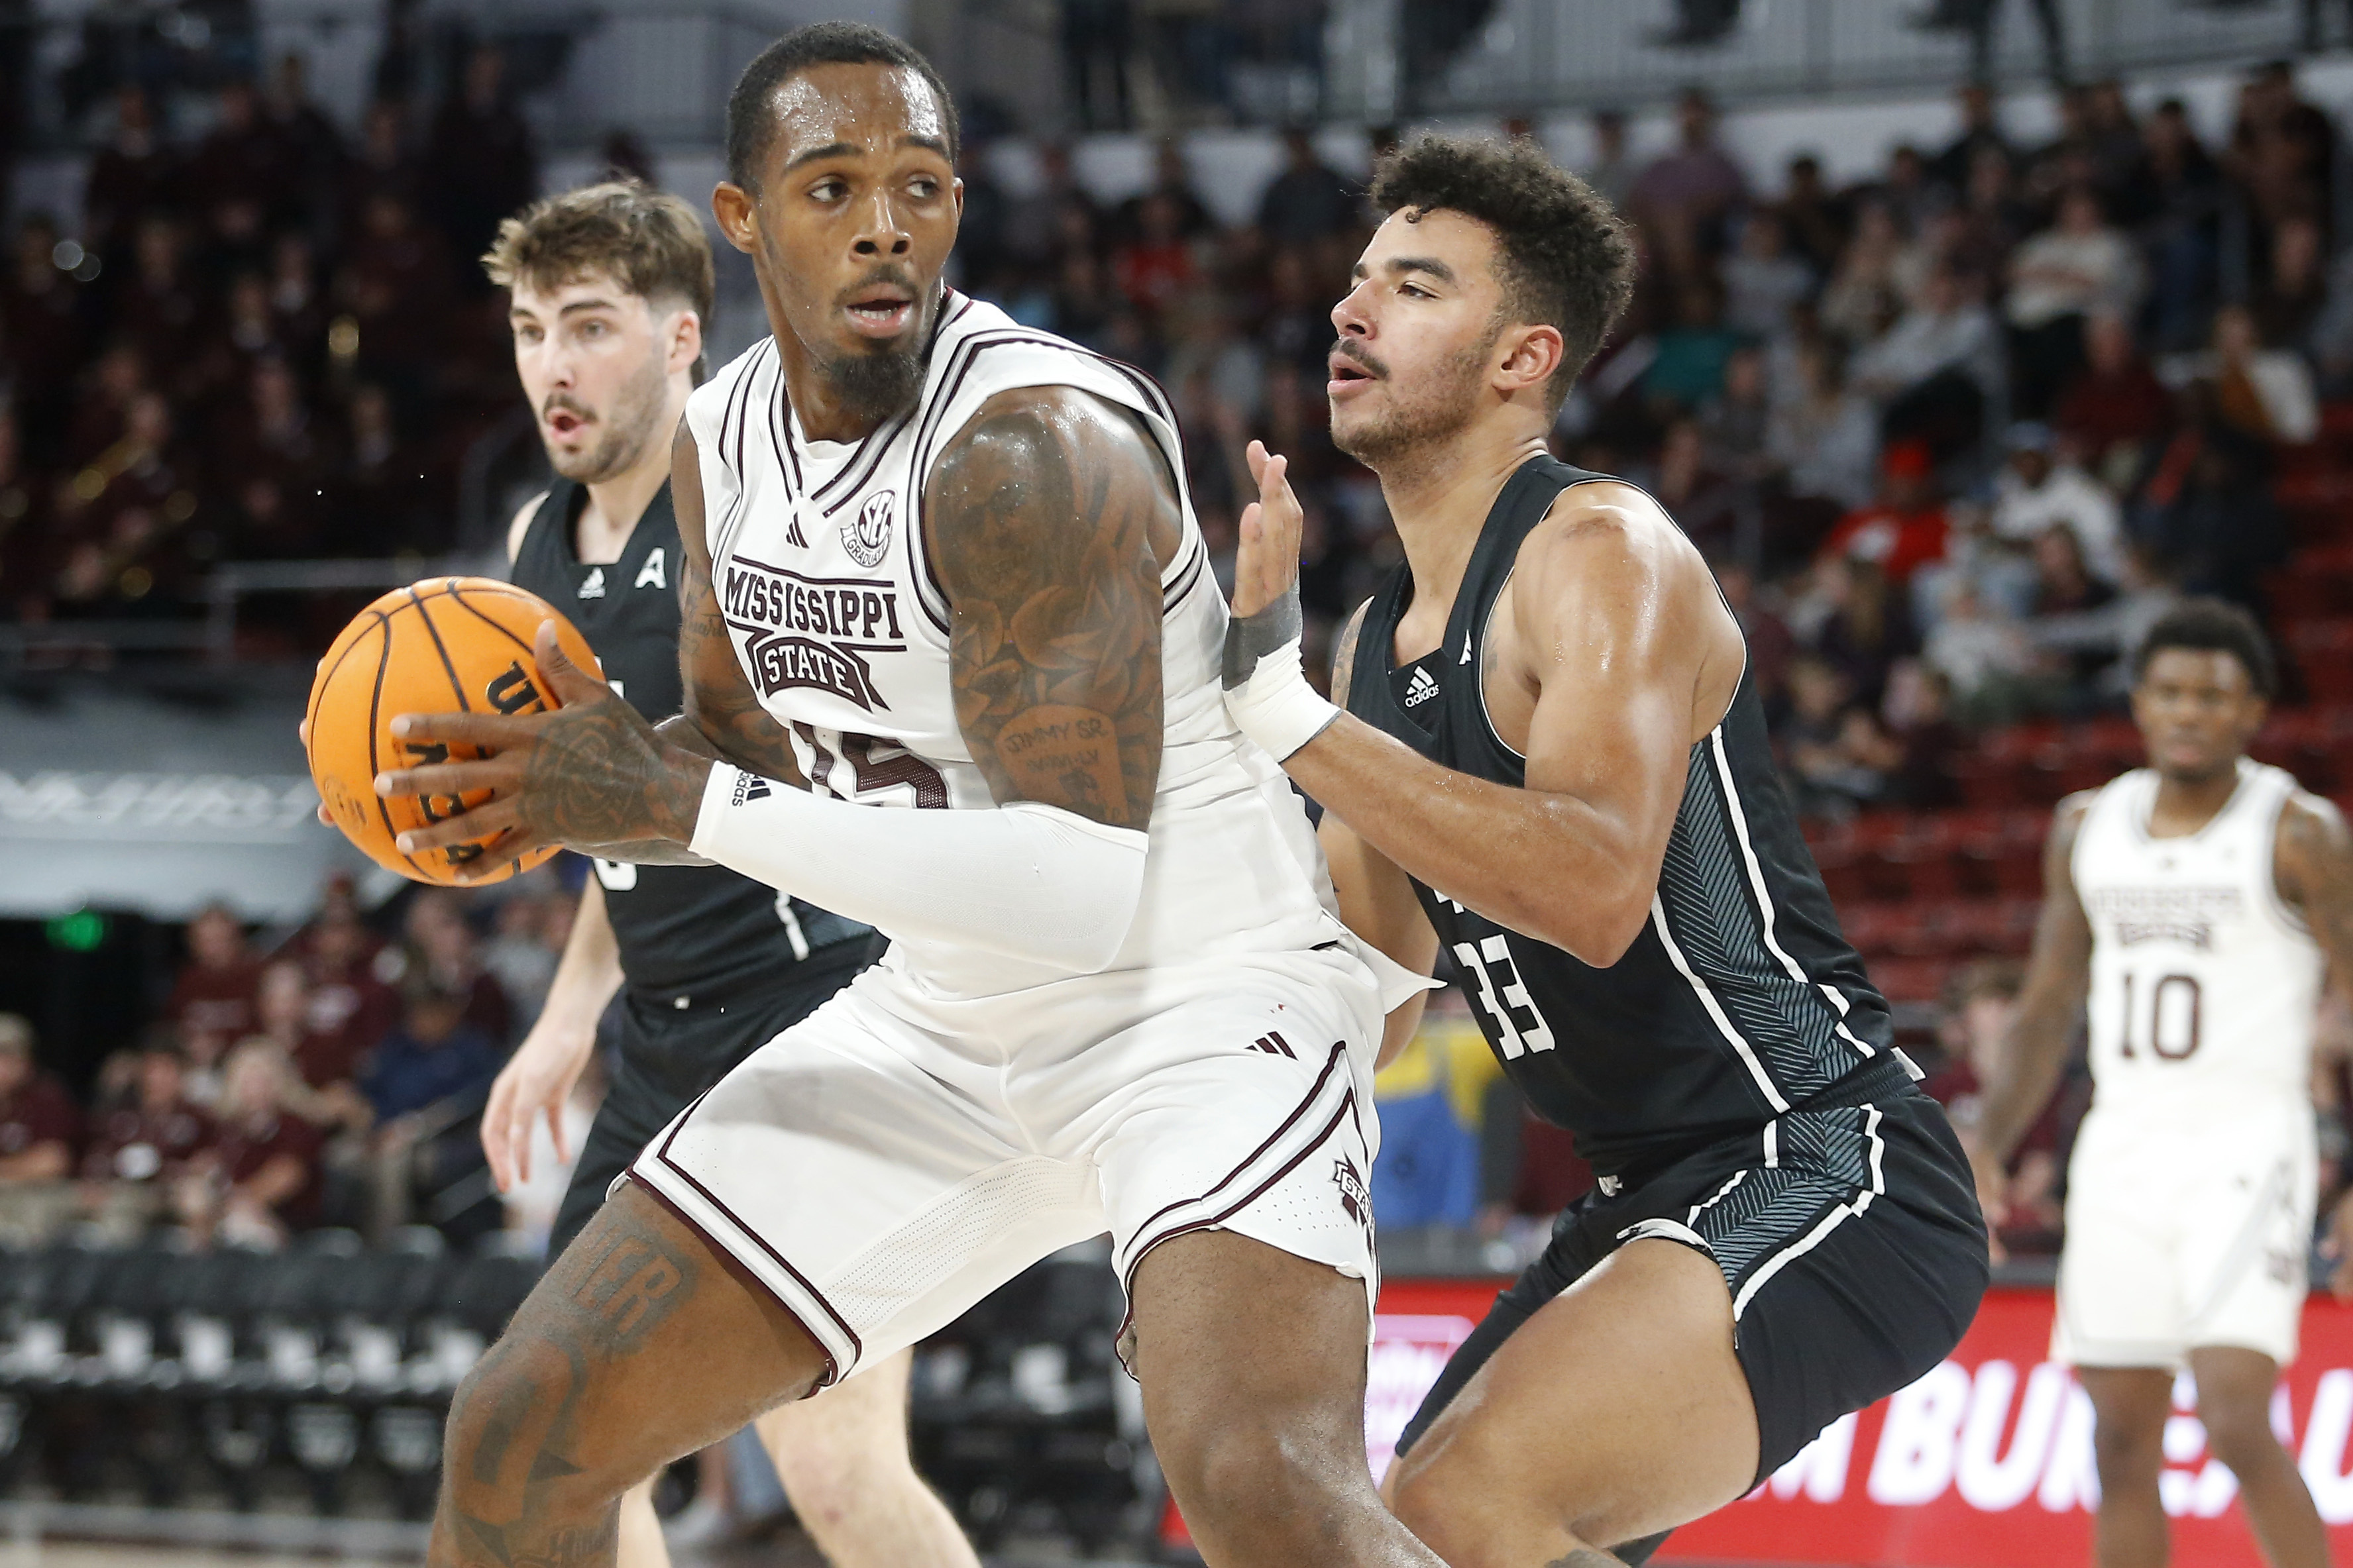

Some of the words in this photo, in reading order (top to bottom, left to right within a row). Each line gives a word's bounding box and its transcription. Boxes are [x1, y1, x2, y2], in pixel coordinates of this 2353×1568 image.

[724, 567, 904, 639] MISSISSIPPI
[764, 645, 854, 696] STATE
[1404, 683, 1439, 707] adidas
[1452, 933, 1556, 1061] 33
[2119, 972, 2203, 1061] 10
